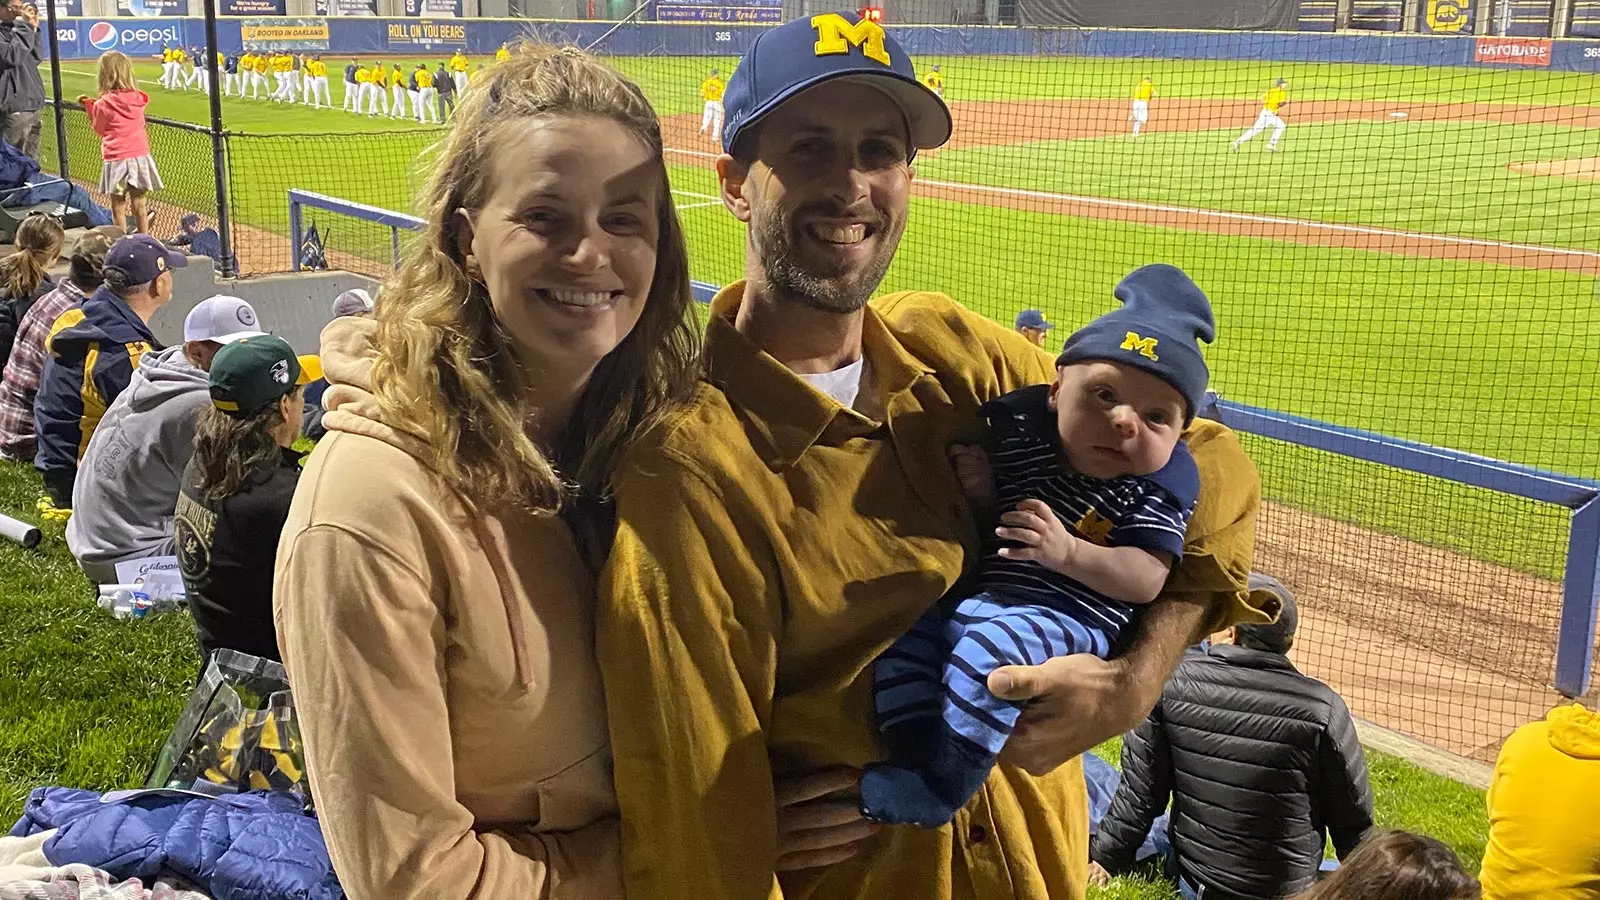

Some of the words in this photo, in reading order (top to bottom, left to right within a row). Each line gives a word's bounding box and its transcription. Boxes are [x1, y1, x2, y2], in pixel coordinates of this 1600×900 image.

[121, 26, 178, 45] pepsi
[388, 24, 408, 37] ROLL
[410, 24, 420, 37] ON
[423, 25, 438, 37] YOU
[440, 25, 465, 38] BEARS
[715, 32, 731, 41] 365
[811, 13, 890, 66] M
[1478, 44, 1547, 57] GATORADE
[1120, 331, 1159, 361] M
[139, 562, 179, 576] Californi
